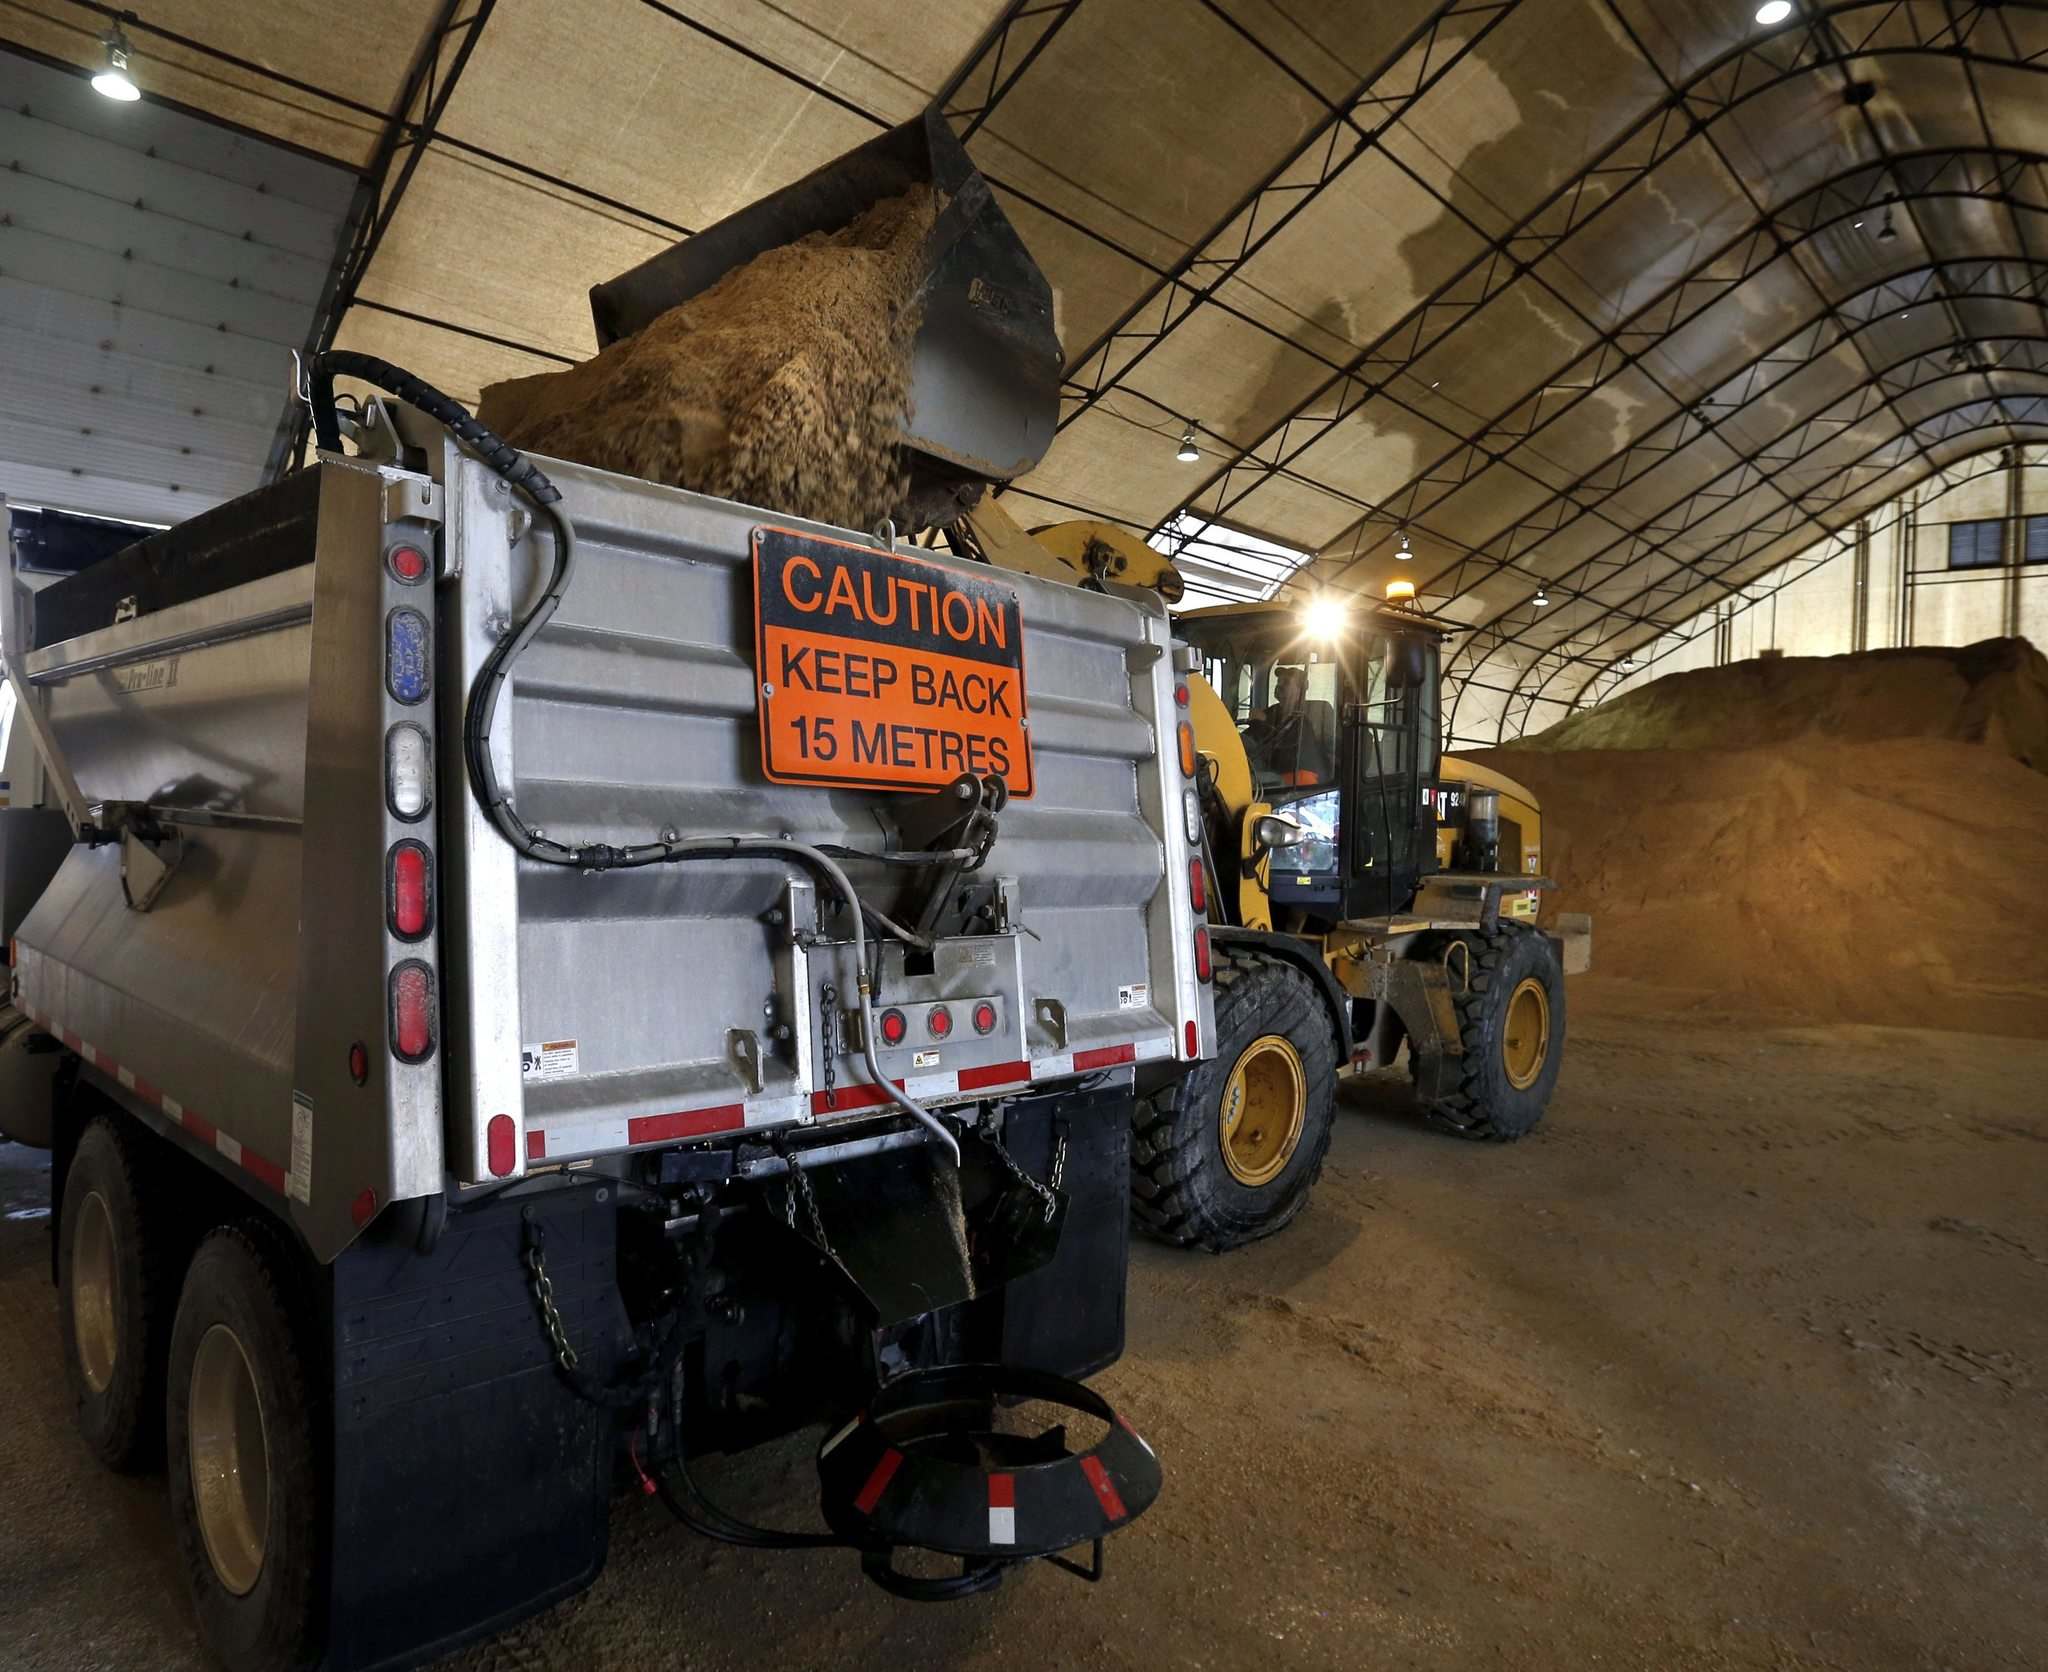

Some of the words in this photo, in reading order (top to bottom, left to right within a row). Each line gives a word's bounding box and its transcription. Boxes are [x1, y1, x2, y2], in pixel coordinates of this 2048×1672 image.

[781, 555, 1007, 649] CAUTION
[780, 643, 898, 700] KEEP
[910, 663, 1012, 719] BACK
[790, 715, 838, 761] 15
[851, 719, 1011, 777] METRES
